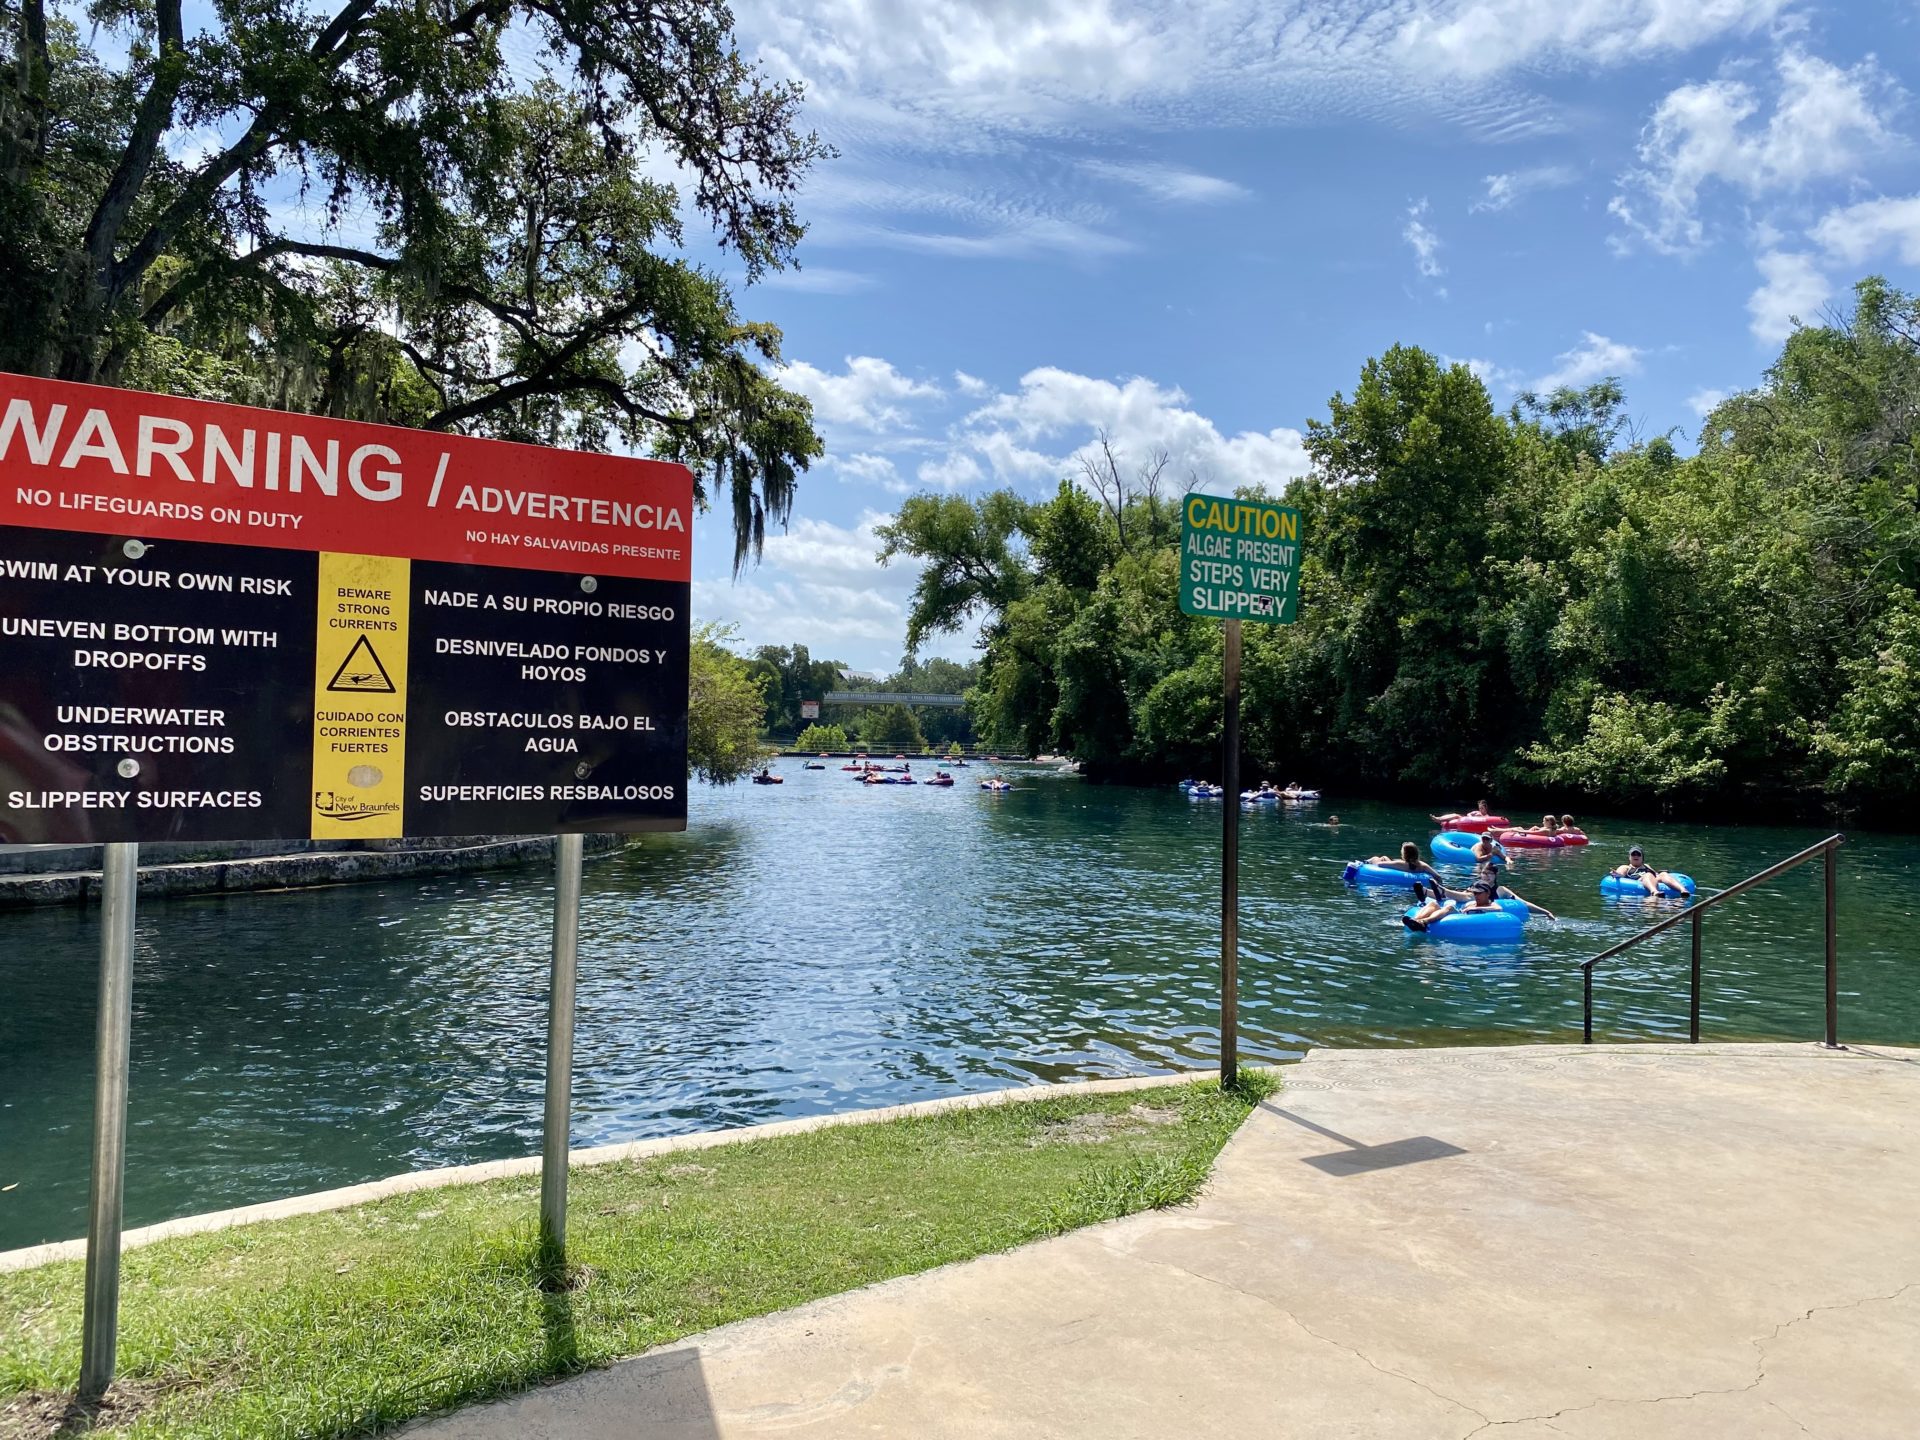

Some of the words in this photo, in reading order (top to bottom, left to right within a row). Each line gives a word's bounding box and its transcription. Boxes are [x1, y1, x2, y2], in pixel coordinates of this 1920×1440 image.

[0, 399, 402, 502] WARNING
[428, 453, 450, 507] /
[456, 485, 685, 533] ADVERTENCIA
[17, 488, 51, 505] NO
[60, 492, 203, 520] LIFEGUARDS
[211, 508, 240, 524] ON
[249, 511, 302, 529] DUTY
[1188, 498, 1297, 541] CAUTION
[466, 530, 487, 543] NO
[491, 532, 520, 546] HAY
[524, 536, 608, 553] SALVAVIDAS
[613, 544, 681, 561] PRESENTE
[1187, 533, 1231, 558] ALGAE
[1237, 539, 1296, 567] PRESENT
[64, 565, 96, 582] AT
[103, 568, 170, 587] YOUR
[178, 573, 232, 591] OWN
[241, 577, 291, 595] RISK
[1191, 560, 1243, 586] STEPS
[1251, 568, 1290, 591] VERY
[338, 588, 391, 600] BEWARE
[338, 604, 389, 615] STRONG
[425, 590, 478, 607] NADE
[484, 595, 497, 609] A
[503, 596, 527, 611] SU
[534, 598, 602, 616] PROPIO
[608, 604, 674, 621] RIESGO
[3, 618, 105, 639] UNEVEN
[115, 624, 214, 644] BOTTOM
[222, 630, 276, 647] WITH
[330, 619, 397, 631] CURRENTS
[75, 650, 206, 671] DROPOFFS
[436, 639, 569, 659] DESNIVELADO
[575, 646, 649, 663] FONDOS
[655, 650, 666, 664] Y
[522, 665, 586, 681] HOYOS
[58, 706, 224, 726] UNDERWATER
[317, 712, 373, 722] CUIDADO
[378, 713, 403, 722] CON
[445, 711, 573, 728] OBSTACULOS
[580, 715, 628, 729] BAJO
[634, 717, 655, 730] EL
[320, 727, 399, 737] CORRIENTES
[44, 734, 234, 753] OBSTRUCTIONS
[332, 743, 388, 753] FUERTES
[525, 738, 578, 752] AGUA
[8, 791, 130, 808] SLIPPERY
[137, 791, 261, 807] SURFACES
[420, 786, 544, 800] SUPERFICIES
[551, 786, 673, 799] RESBALOSOS
[335, 803, 358, 811] New
[360, 803, 400, 811] Braunfels
